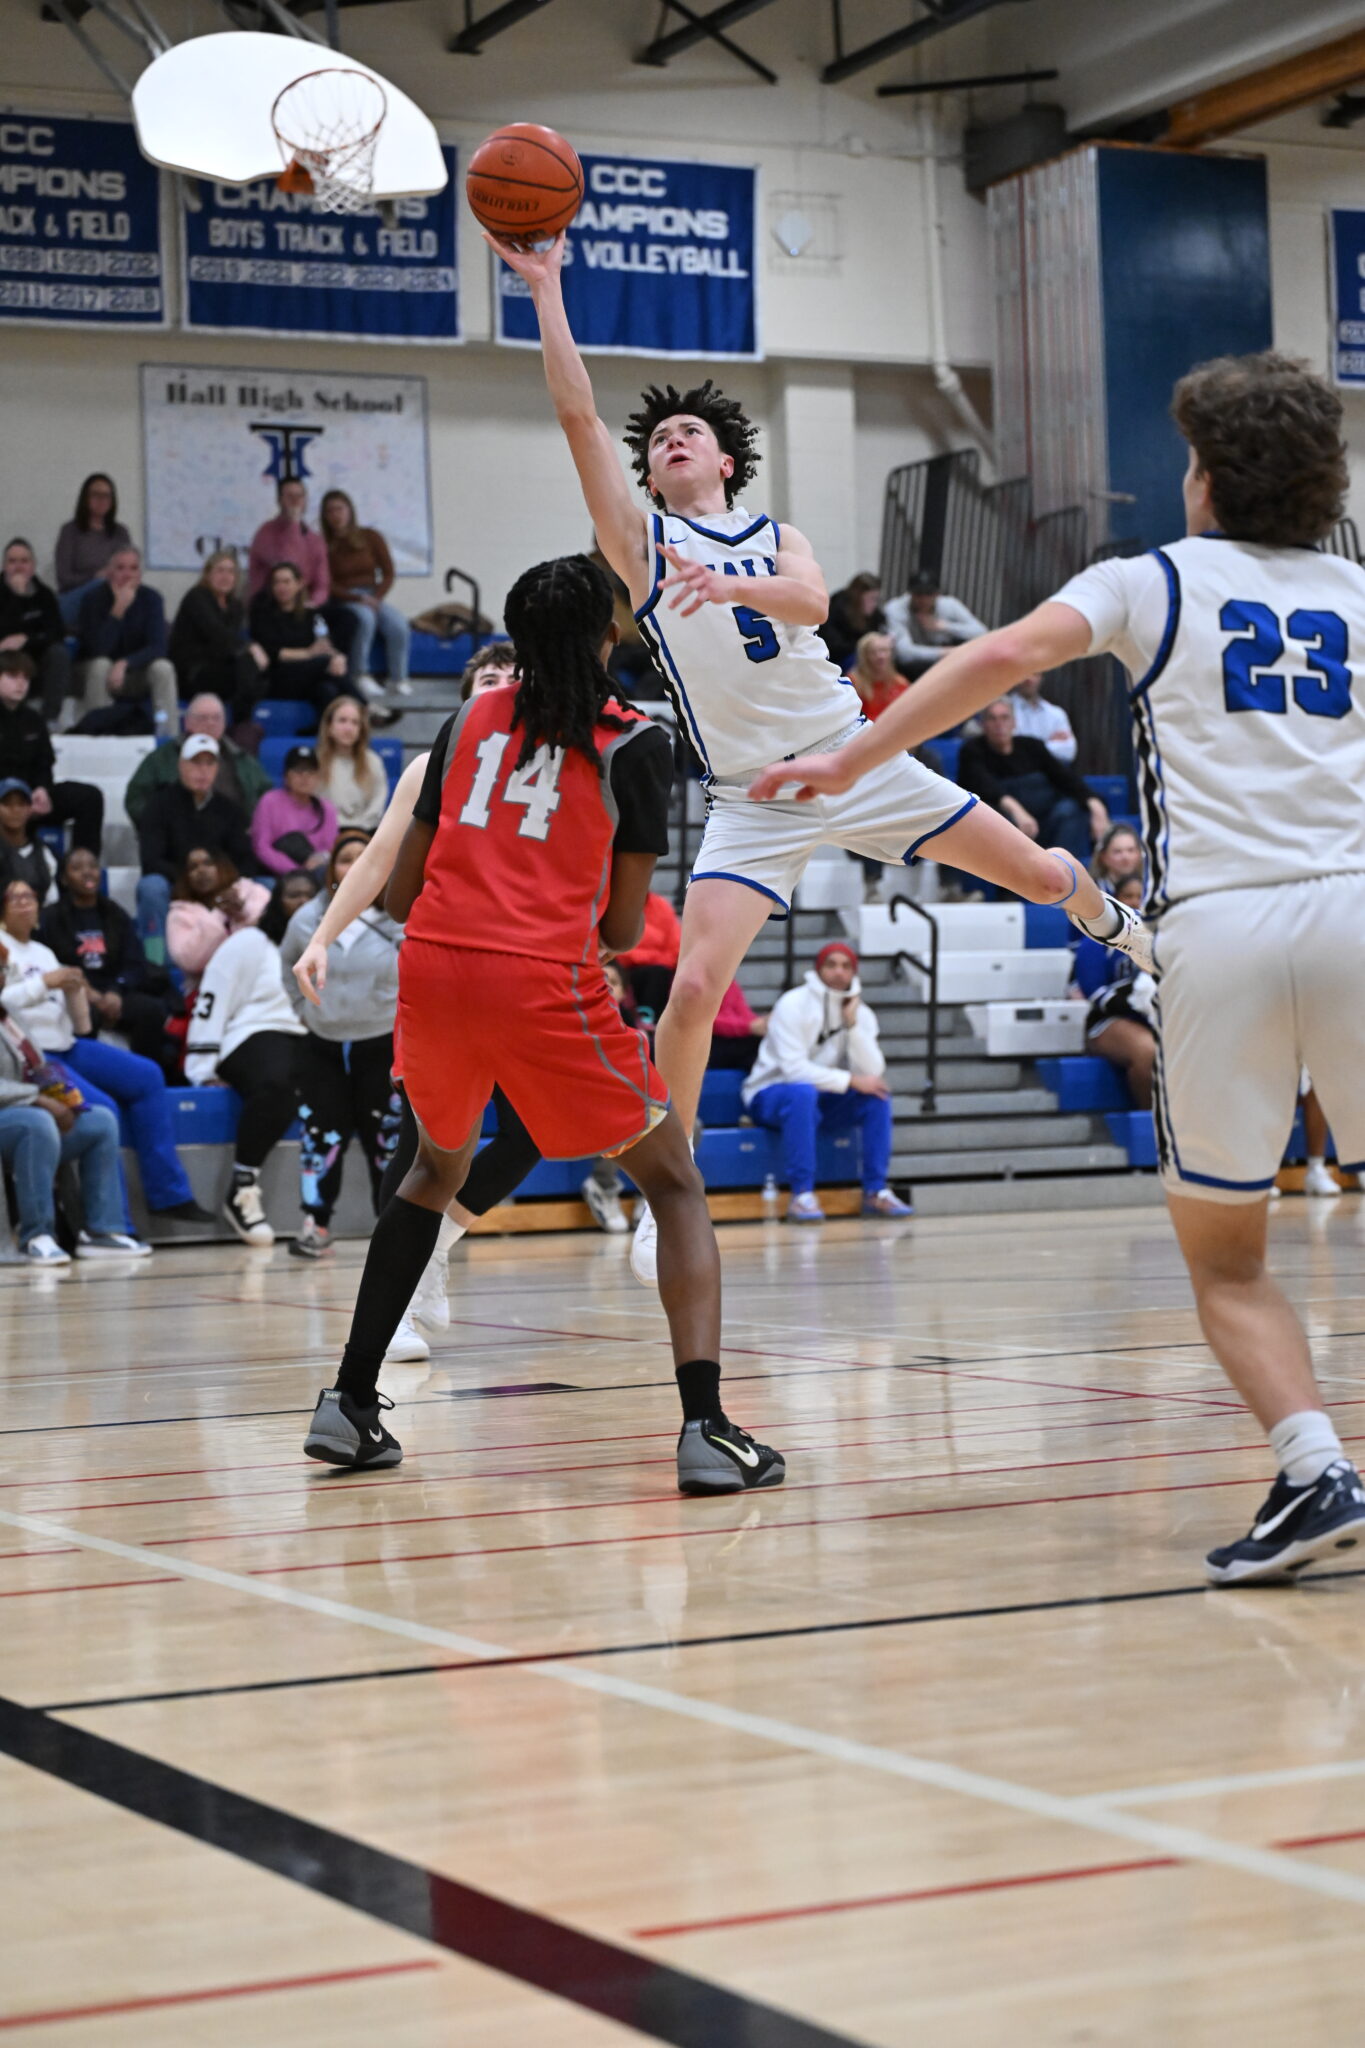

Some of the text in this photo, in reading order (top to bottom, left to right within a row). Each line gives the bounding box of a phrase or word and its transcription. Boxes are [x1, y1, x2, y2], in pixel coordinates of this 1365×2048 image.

[0, 164, 127, 201] PIONS
[590, 165, 668, 198] CCC
[44, 212, 60, 237] &
[67, 210, 131, 241] FIELD
[209, 219, 438, 258] BOYS TRACK & FIELD
[570, 202, 729, 240] AMPIONS
[581, 239, 749, 278] VOLLEYBALL
[165, 383, 404, 413] Hall High School
[732, 604, 781, 664] 5
[1219, 598, 1353, 720] 23
[458, 731, 566, 842] 14
